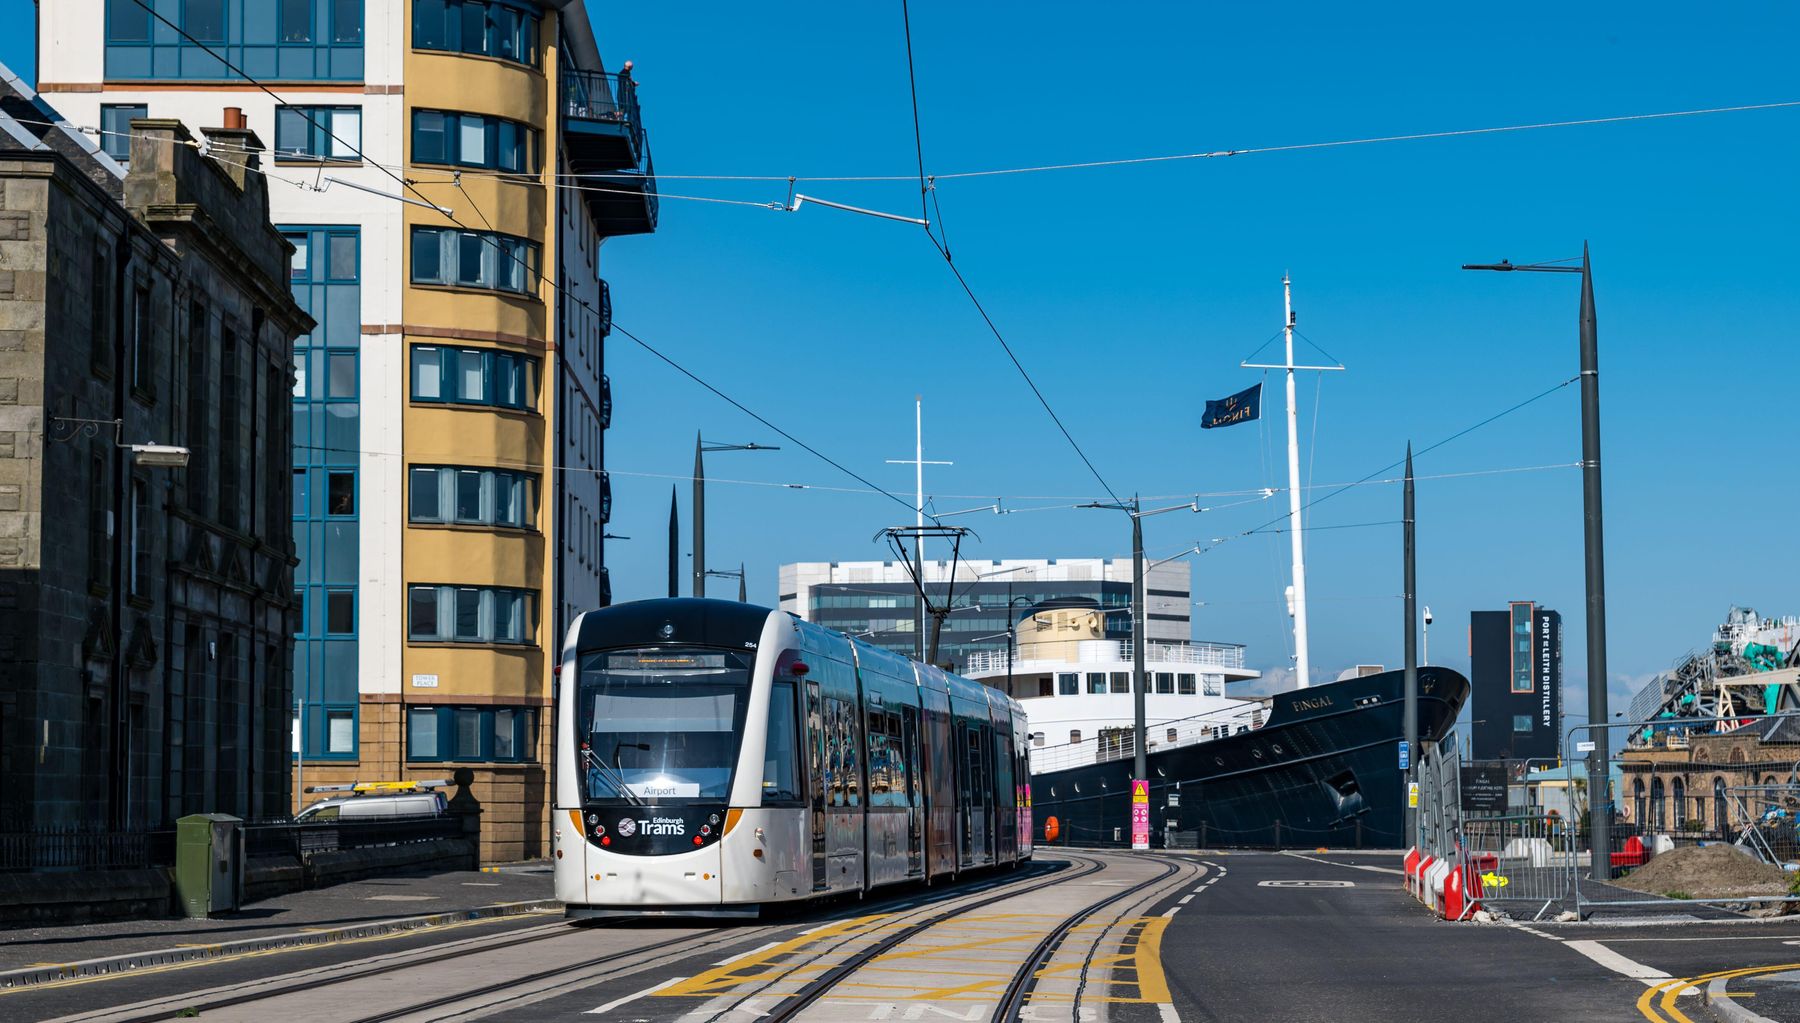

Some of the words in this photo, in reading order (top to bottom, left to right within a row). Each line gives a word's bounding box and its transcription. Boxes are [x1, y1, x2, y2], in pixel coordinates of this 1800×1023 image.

[1542, 616, 1550, 640] PORT
[744, 641, 757, 649] 254
[1542, 648, 1550, 674] LEITH
[1292, 695, 1334, 712] FINGAL
[1542, 675, 1550, 727] DISTILLERY
[643, 786, 677, 797] Airport
[638, 820, 685, 836] Trams
[652, 817, 684, 825] Edinburgh
